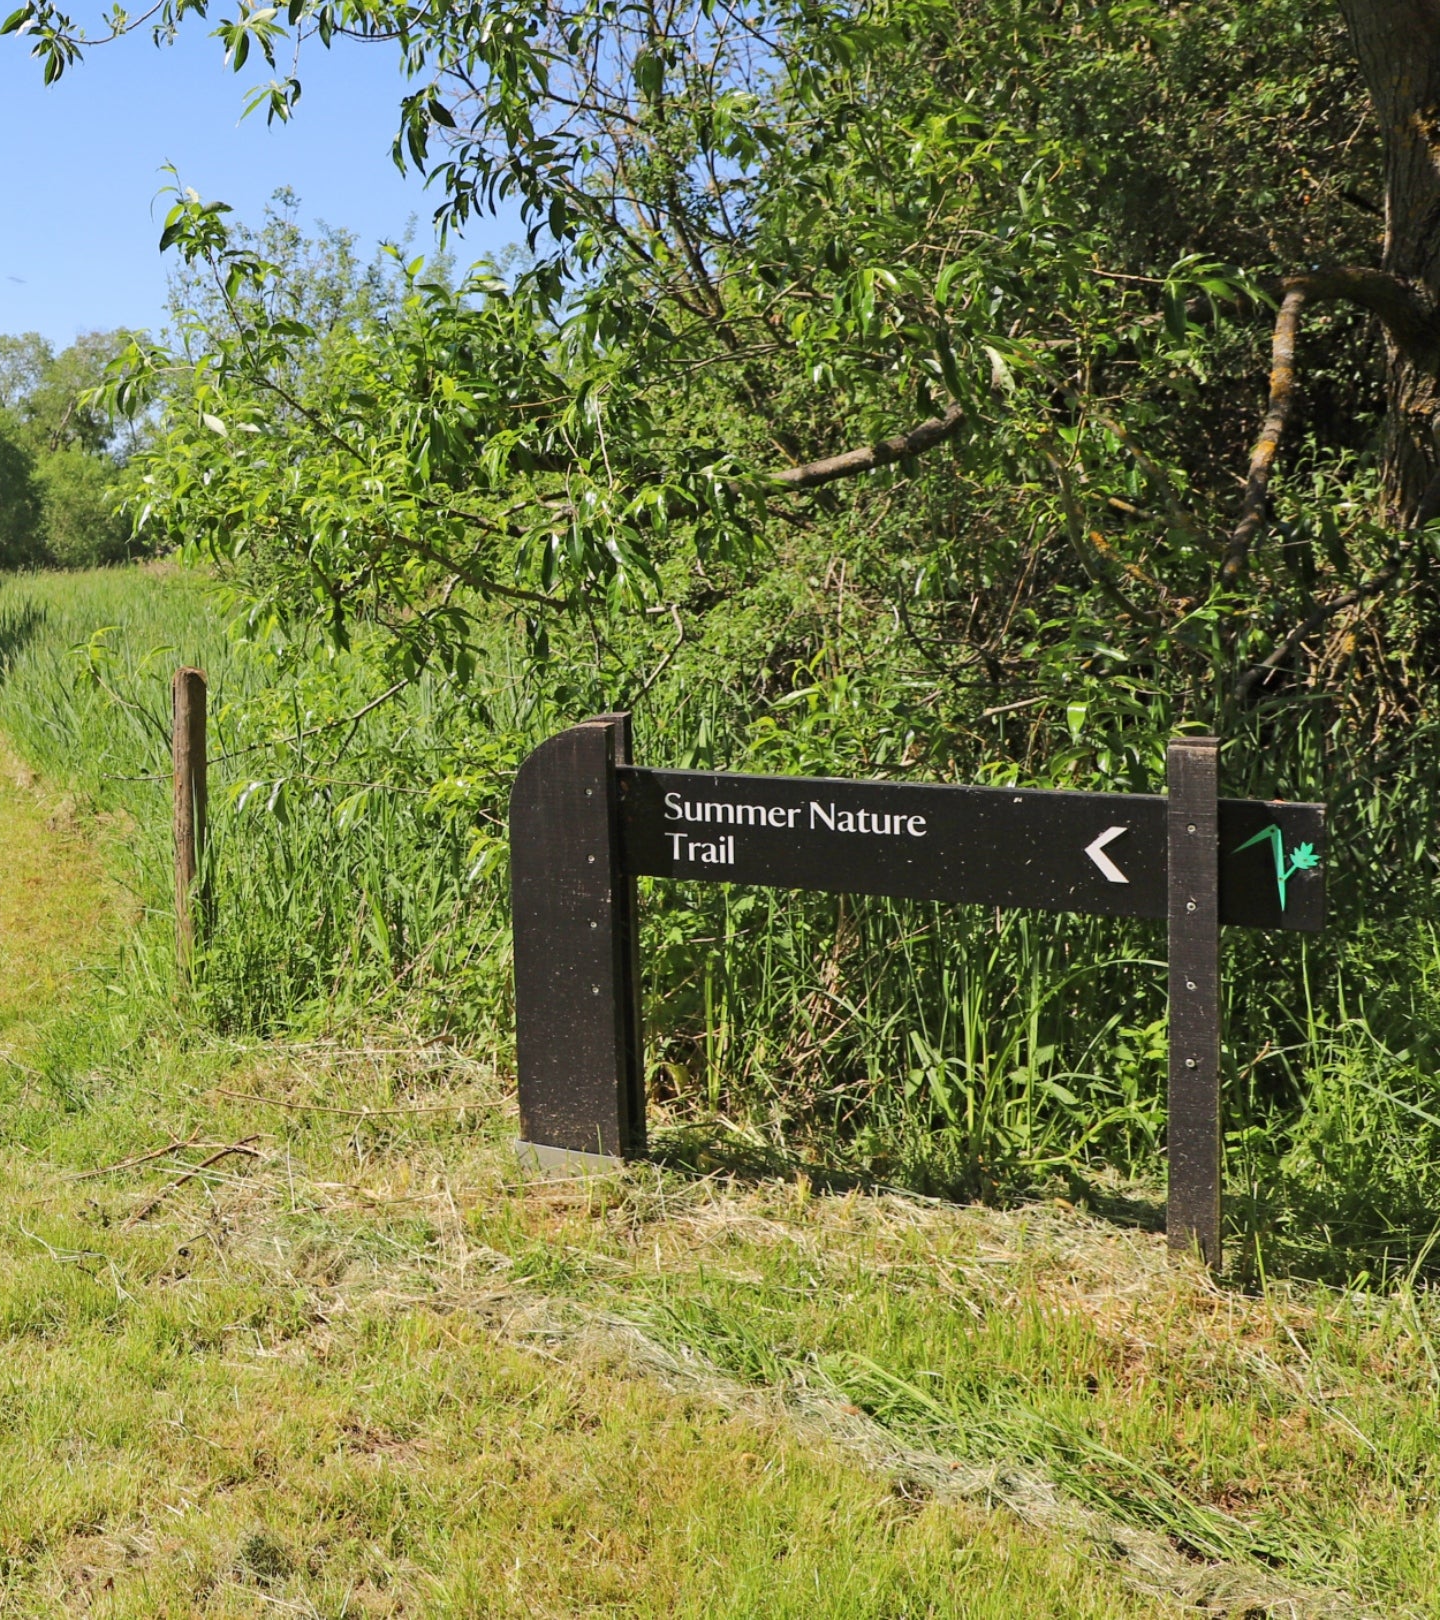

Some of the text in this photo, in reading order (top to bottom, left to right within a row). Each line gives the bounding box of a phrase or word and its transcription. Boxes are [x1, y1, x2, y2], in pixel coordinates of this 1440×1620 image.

[663, 791, 928, 838] Summer Nature
[664, 832, 736, 865] Trail
